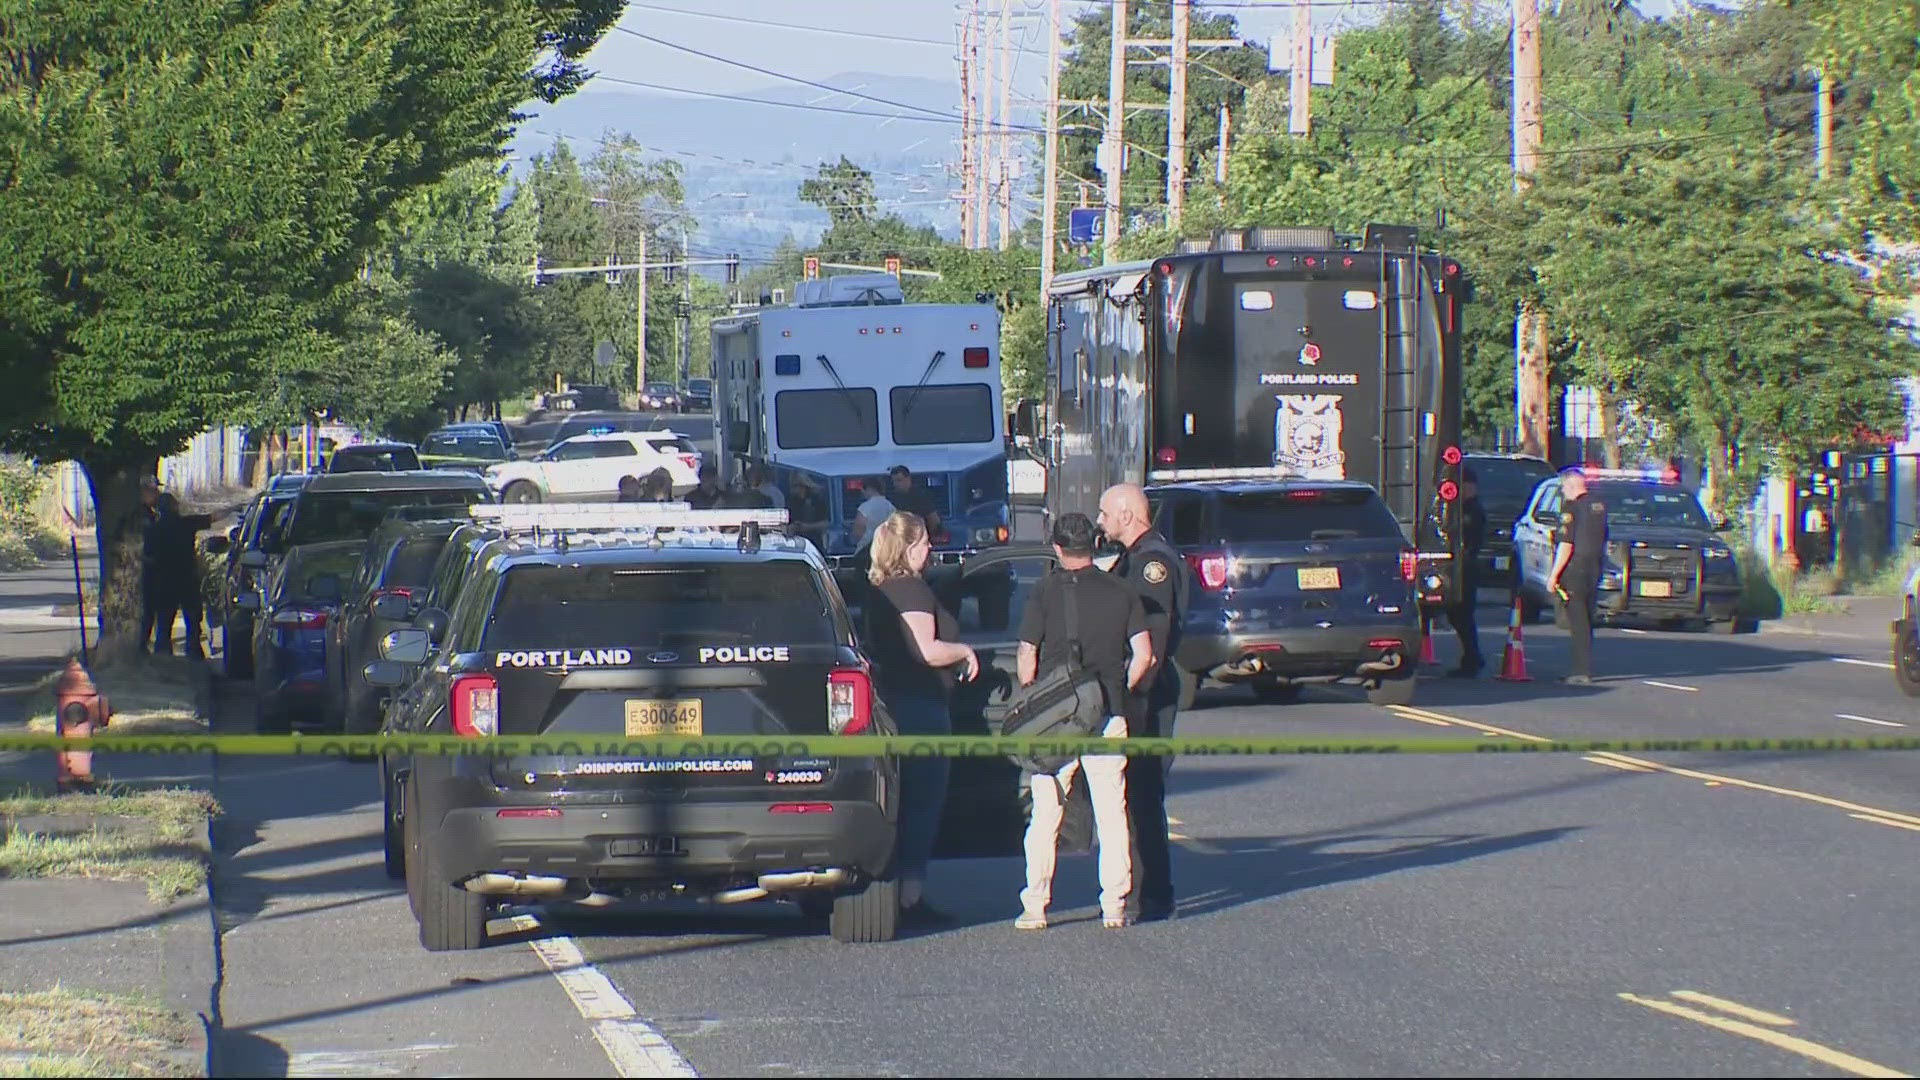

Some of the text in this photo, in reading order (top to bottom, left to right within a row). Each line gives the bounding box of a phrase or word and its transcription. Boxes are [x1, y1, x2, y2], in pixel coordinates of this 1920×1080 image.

[1261, 374, 1357, 385] PORTLAND POLICE
[495, 650, 631, 667] PORTLAND
[700, 647, 789, 662] POLICE
[630, 708, 697, 725] E300649
[575, 760, 752, 774] JOINPORTLANDPOLICE.COM
[525, 773, 536, 784] C
[777, 771, 822, 783] 240030
